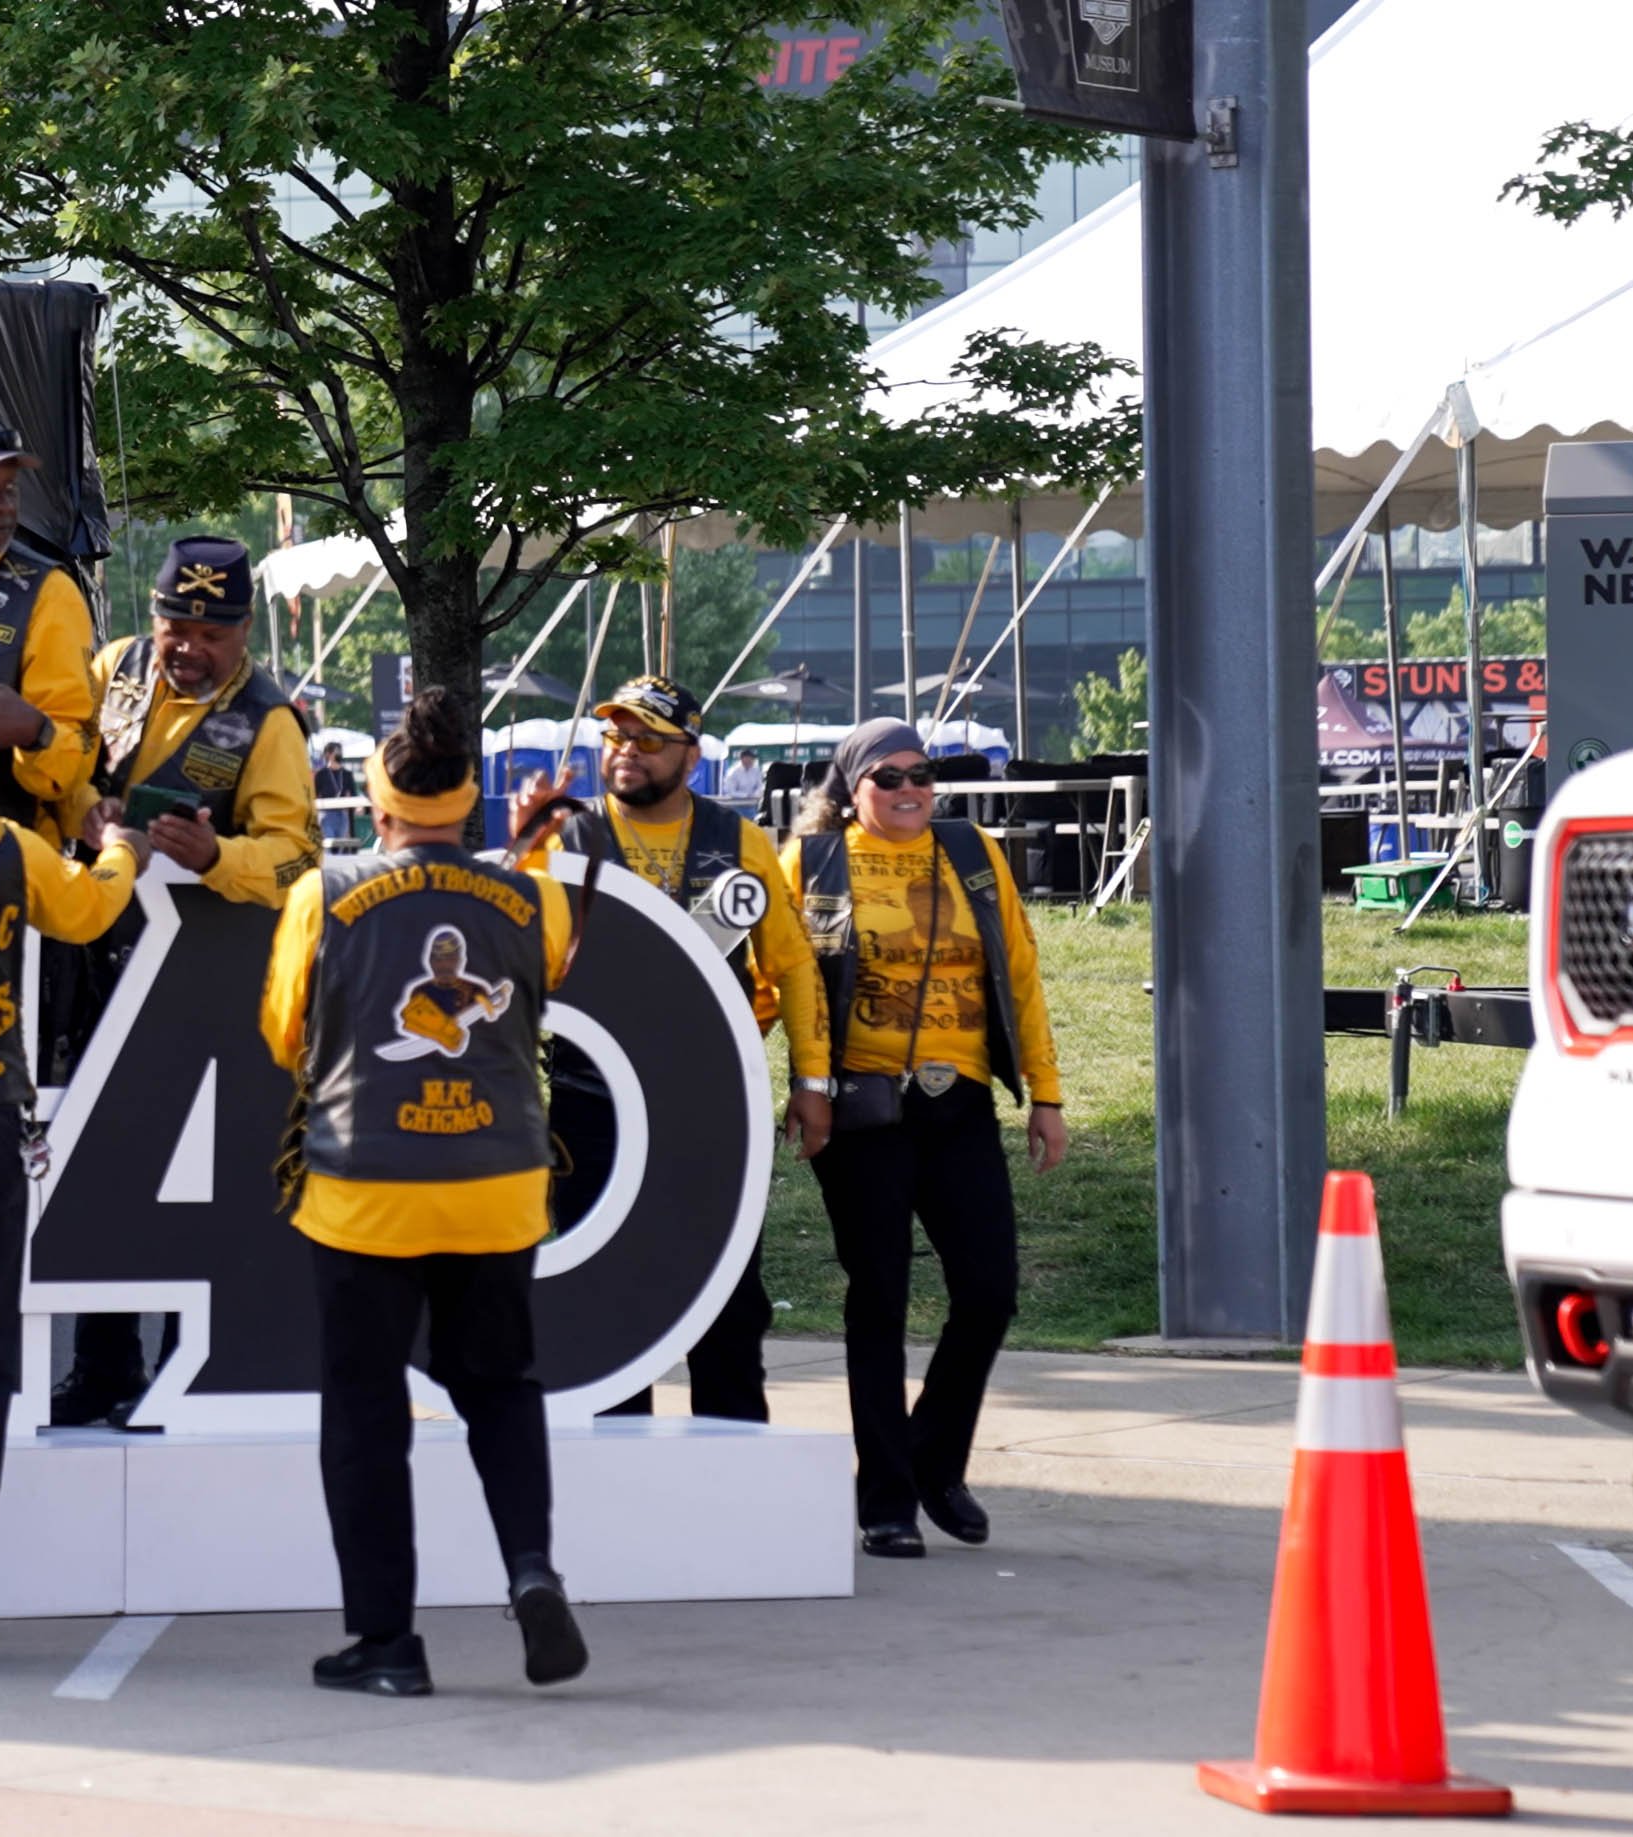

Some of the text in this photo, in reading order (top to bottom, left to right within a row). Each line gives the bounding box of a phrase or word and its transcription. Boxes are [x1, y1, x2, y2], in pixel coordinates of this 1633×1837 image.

[1084, 53, 1132, 74] MUSEUM
[1579, 537, 1633, 569] W
[329, 863, 426, 927] BUFFALO
[397, 1100, 494, 1134] CHICAGO
